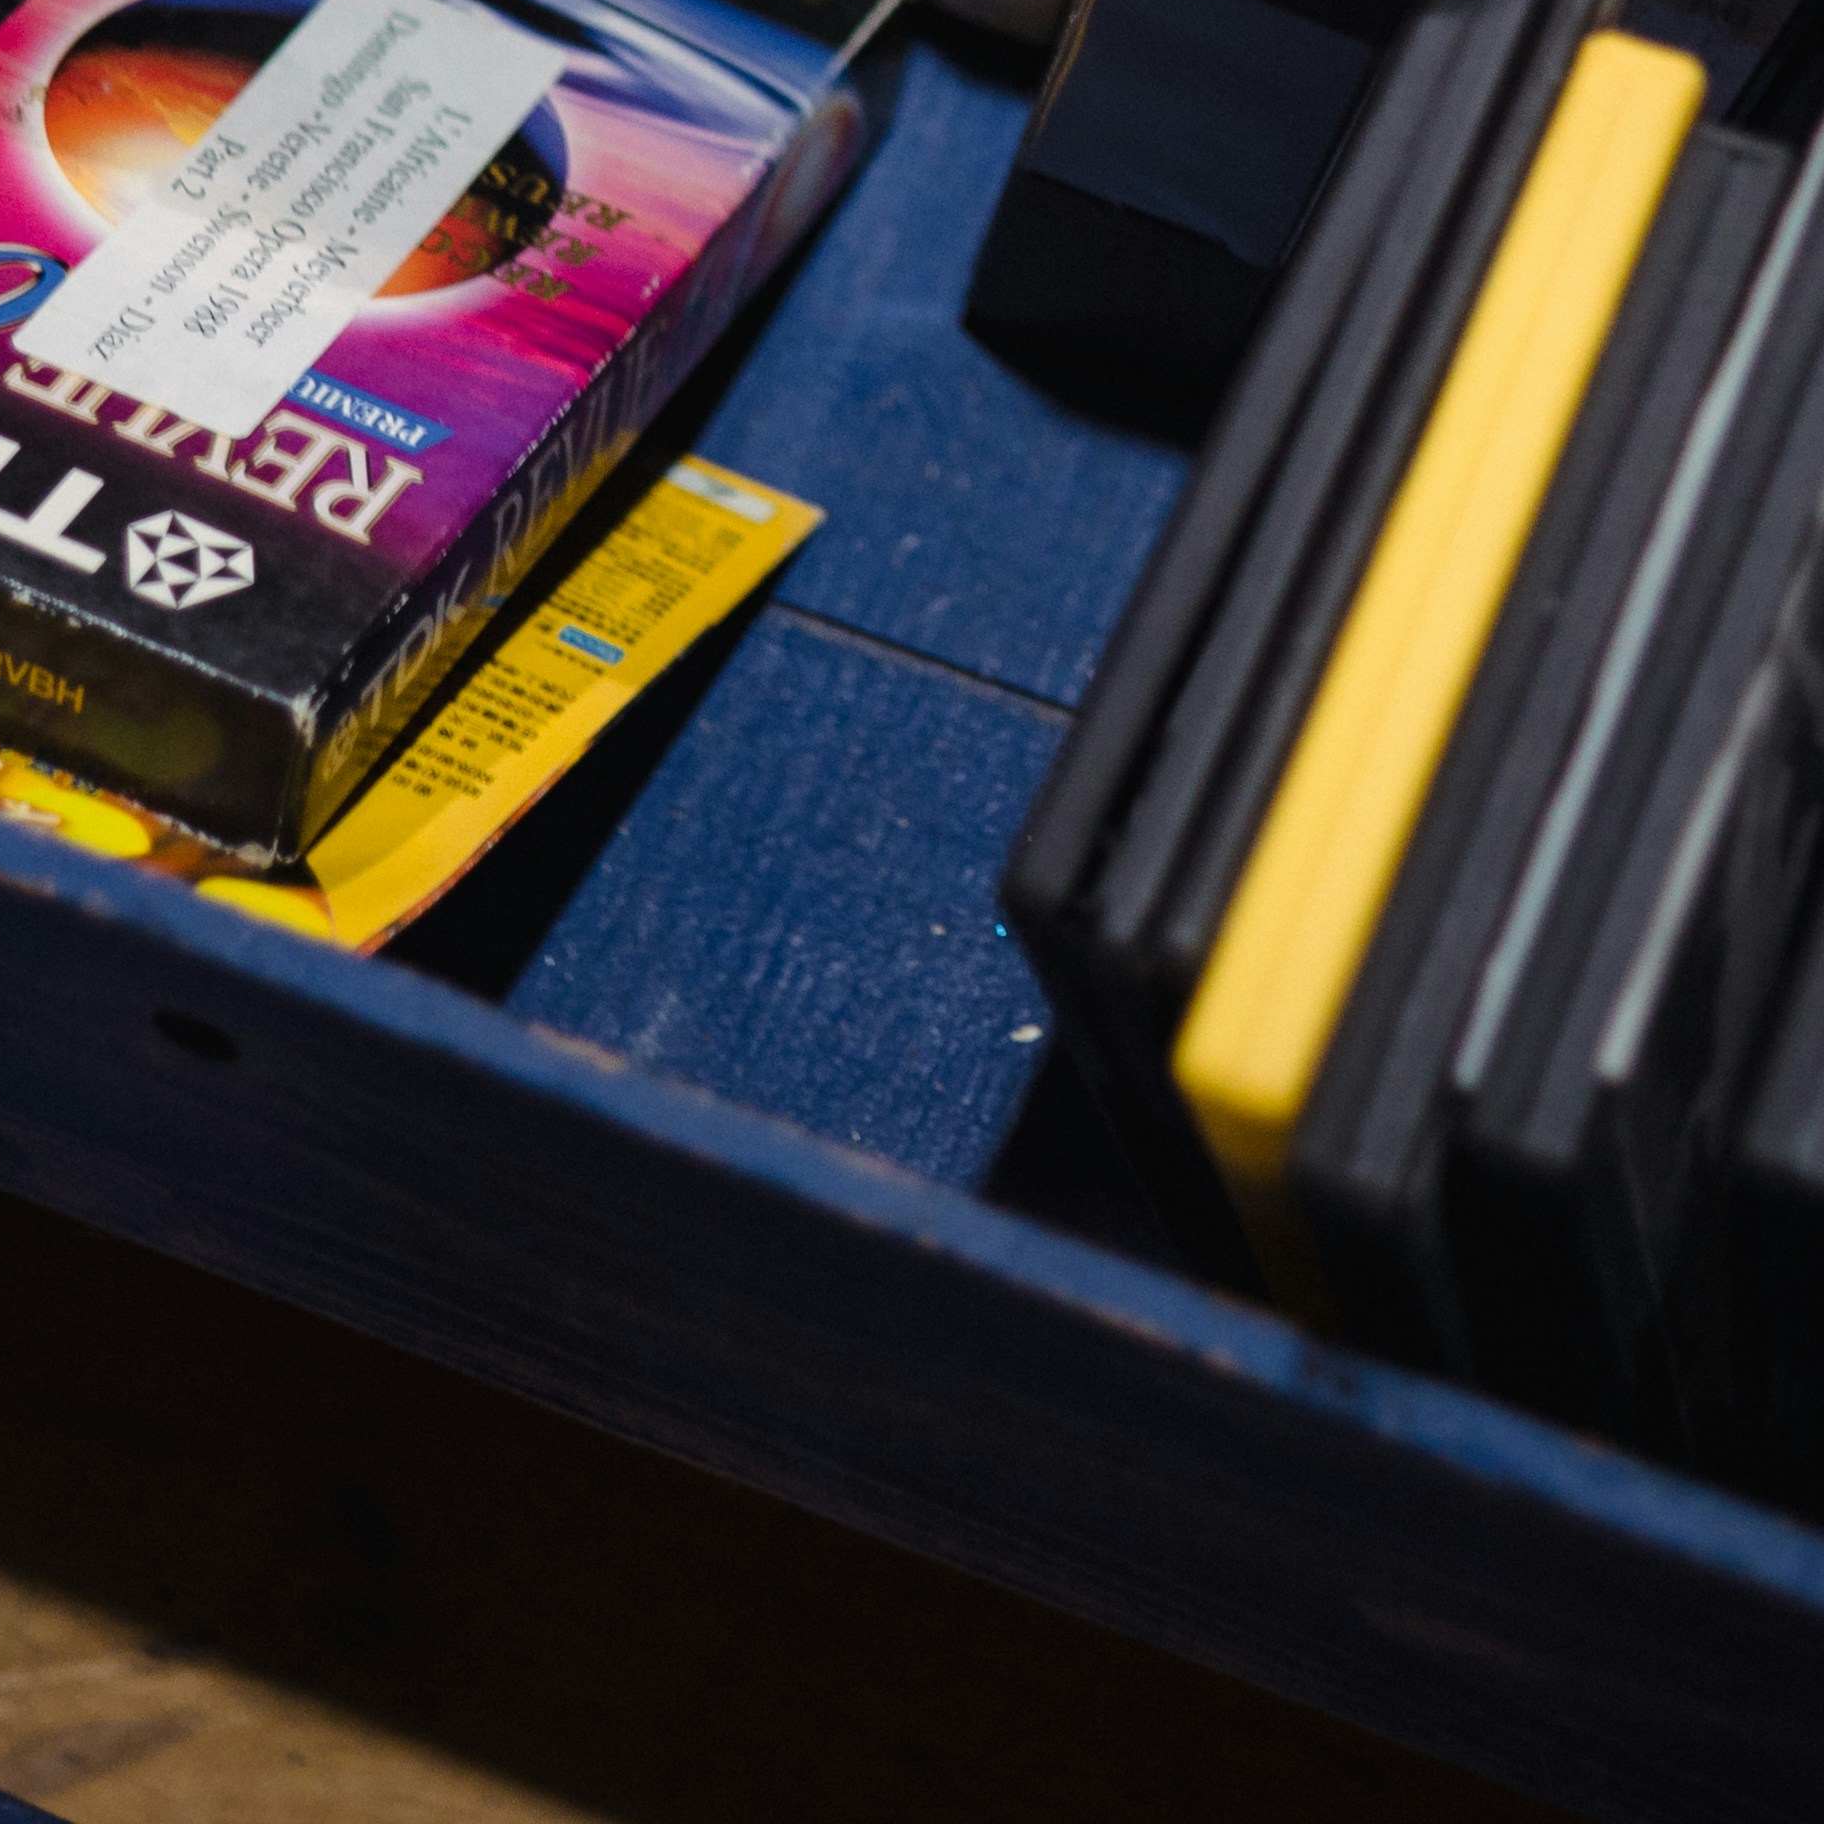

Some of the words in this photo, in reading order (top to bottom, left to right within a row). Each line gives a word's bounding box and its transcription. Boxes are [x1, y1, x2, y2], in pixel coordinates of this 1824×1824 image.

[314, 8, 423, 112] Domingo
[377, 72, 435, 122] San
[170, 174, 207, 203] 2
[182, 132, 250, 185] Part
[288, 116, 402, 221] Francisco
[477, 157, 629, 237] REUS
[147, 201, 255, 296] Swenson
[231, 216, 307, 285] Opera
[416, 227, 573, 307] RECO
[181, 280, 253, 342] 1988
[253, 235, 361, 348] Meyerbeer
[287, 371, 429, 451] PREMIU
[358, 585, 471, 733] TDK
